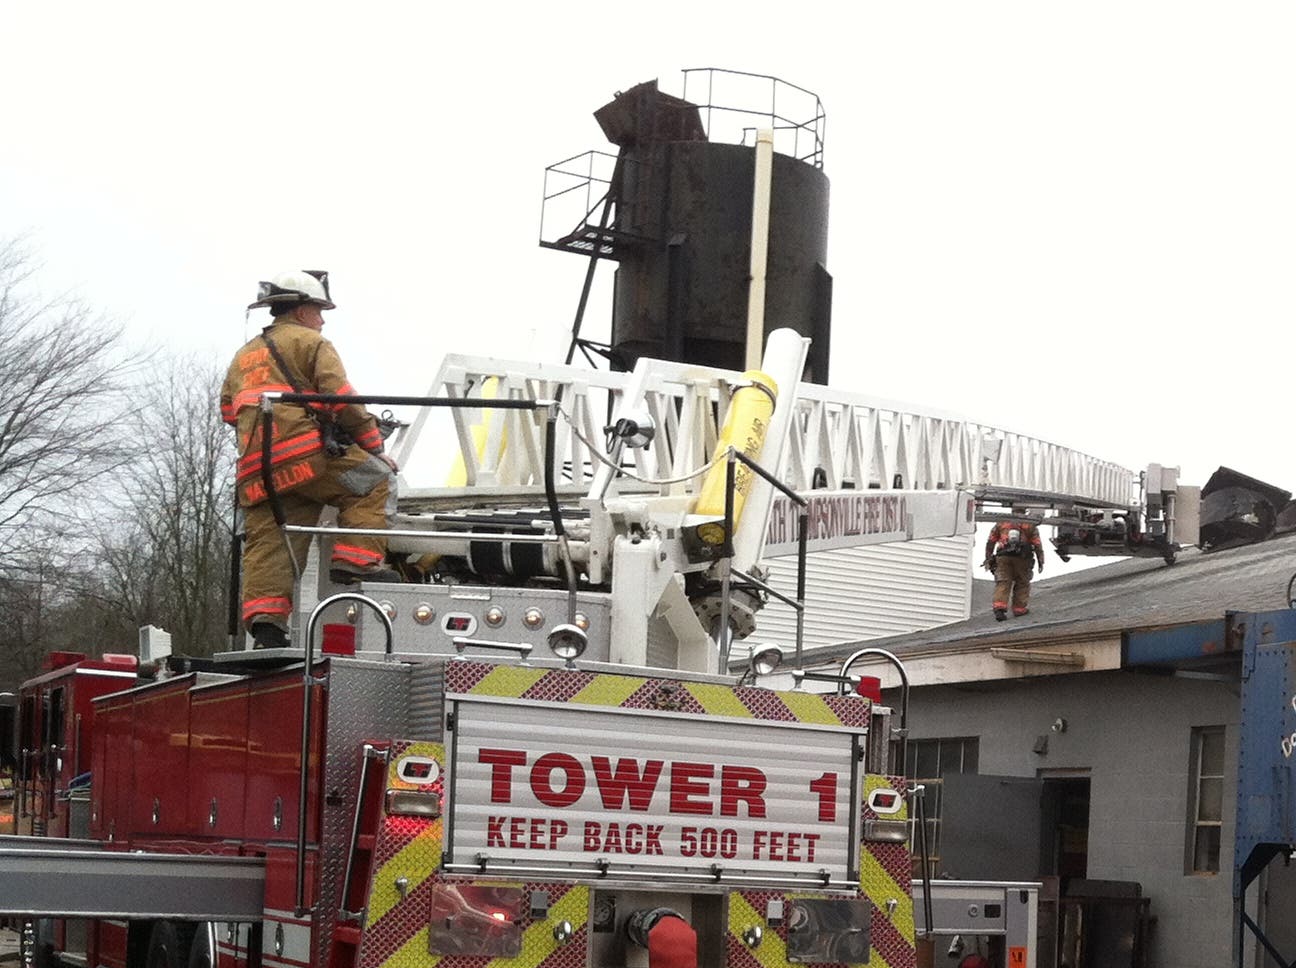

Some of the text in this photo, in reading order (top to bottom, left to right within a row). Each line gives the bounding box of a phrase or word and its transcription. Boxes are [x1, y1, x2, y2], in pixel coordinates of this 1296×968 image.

[478, 748, 838, 822] TOWER 1
[487, 816, 821, 863] KEEP BACK 500 FEET
